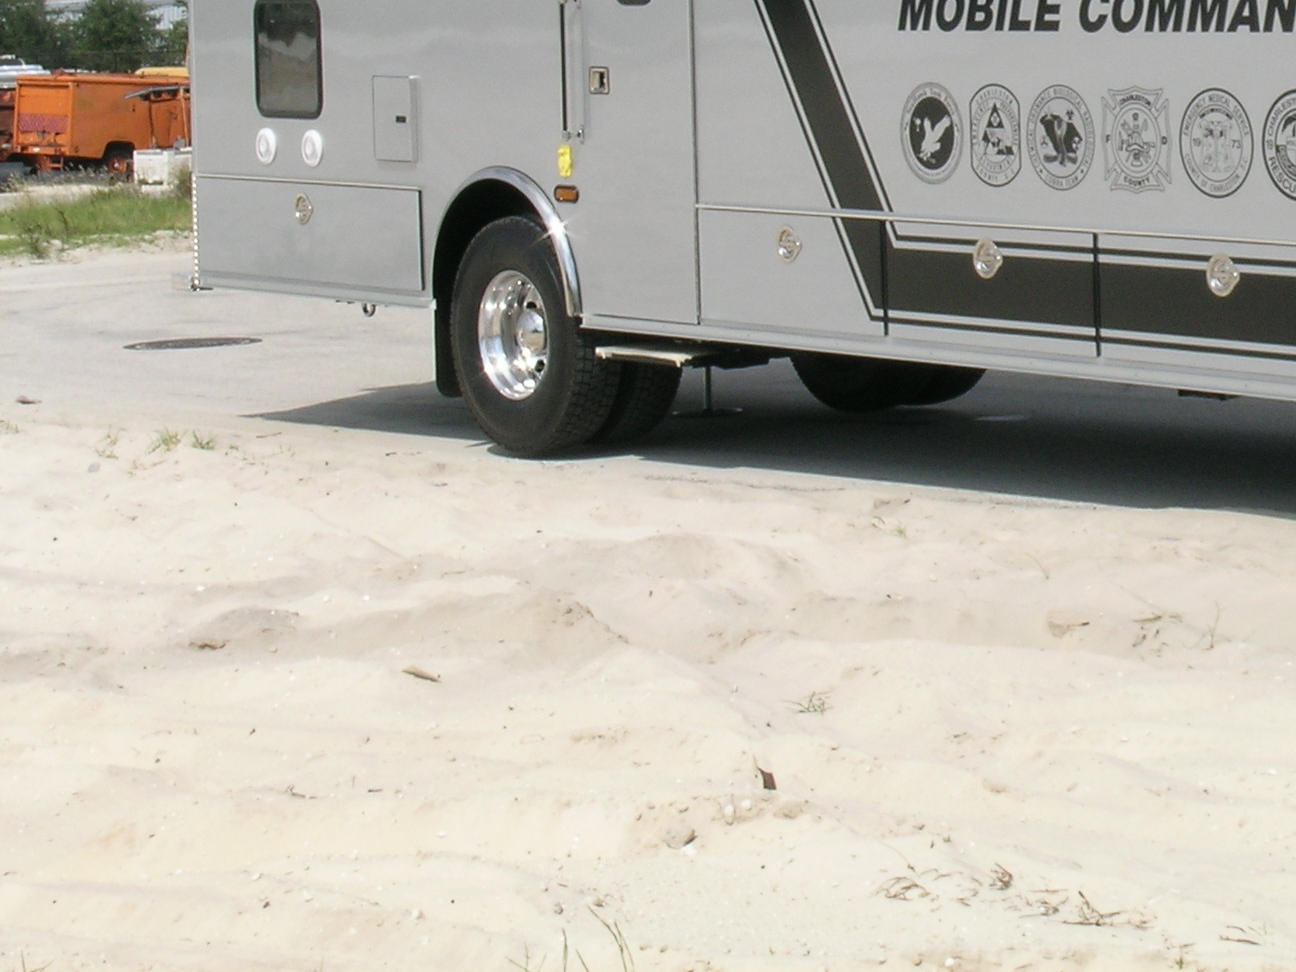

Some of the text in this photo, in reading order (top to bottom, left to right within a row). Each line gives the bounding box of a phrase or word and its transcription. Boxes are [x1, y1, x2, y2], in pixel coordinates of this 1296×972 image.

[1105, 133, 1111, 143] F
[1231, 139, 1242, 149] 73
[1123, 176, 1150, 187] COUNTY
